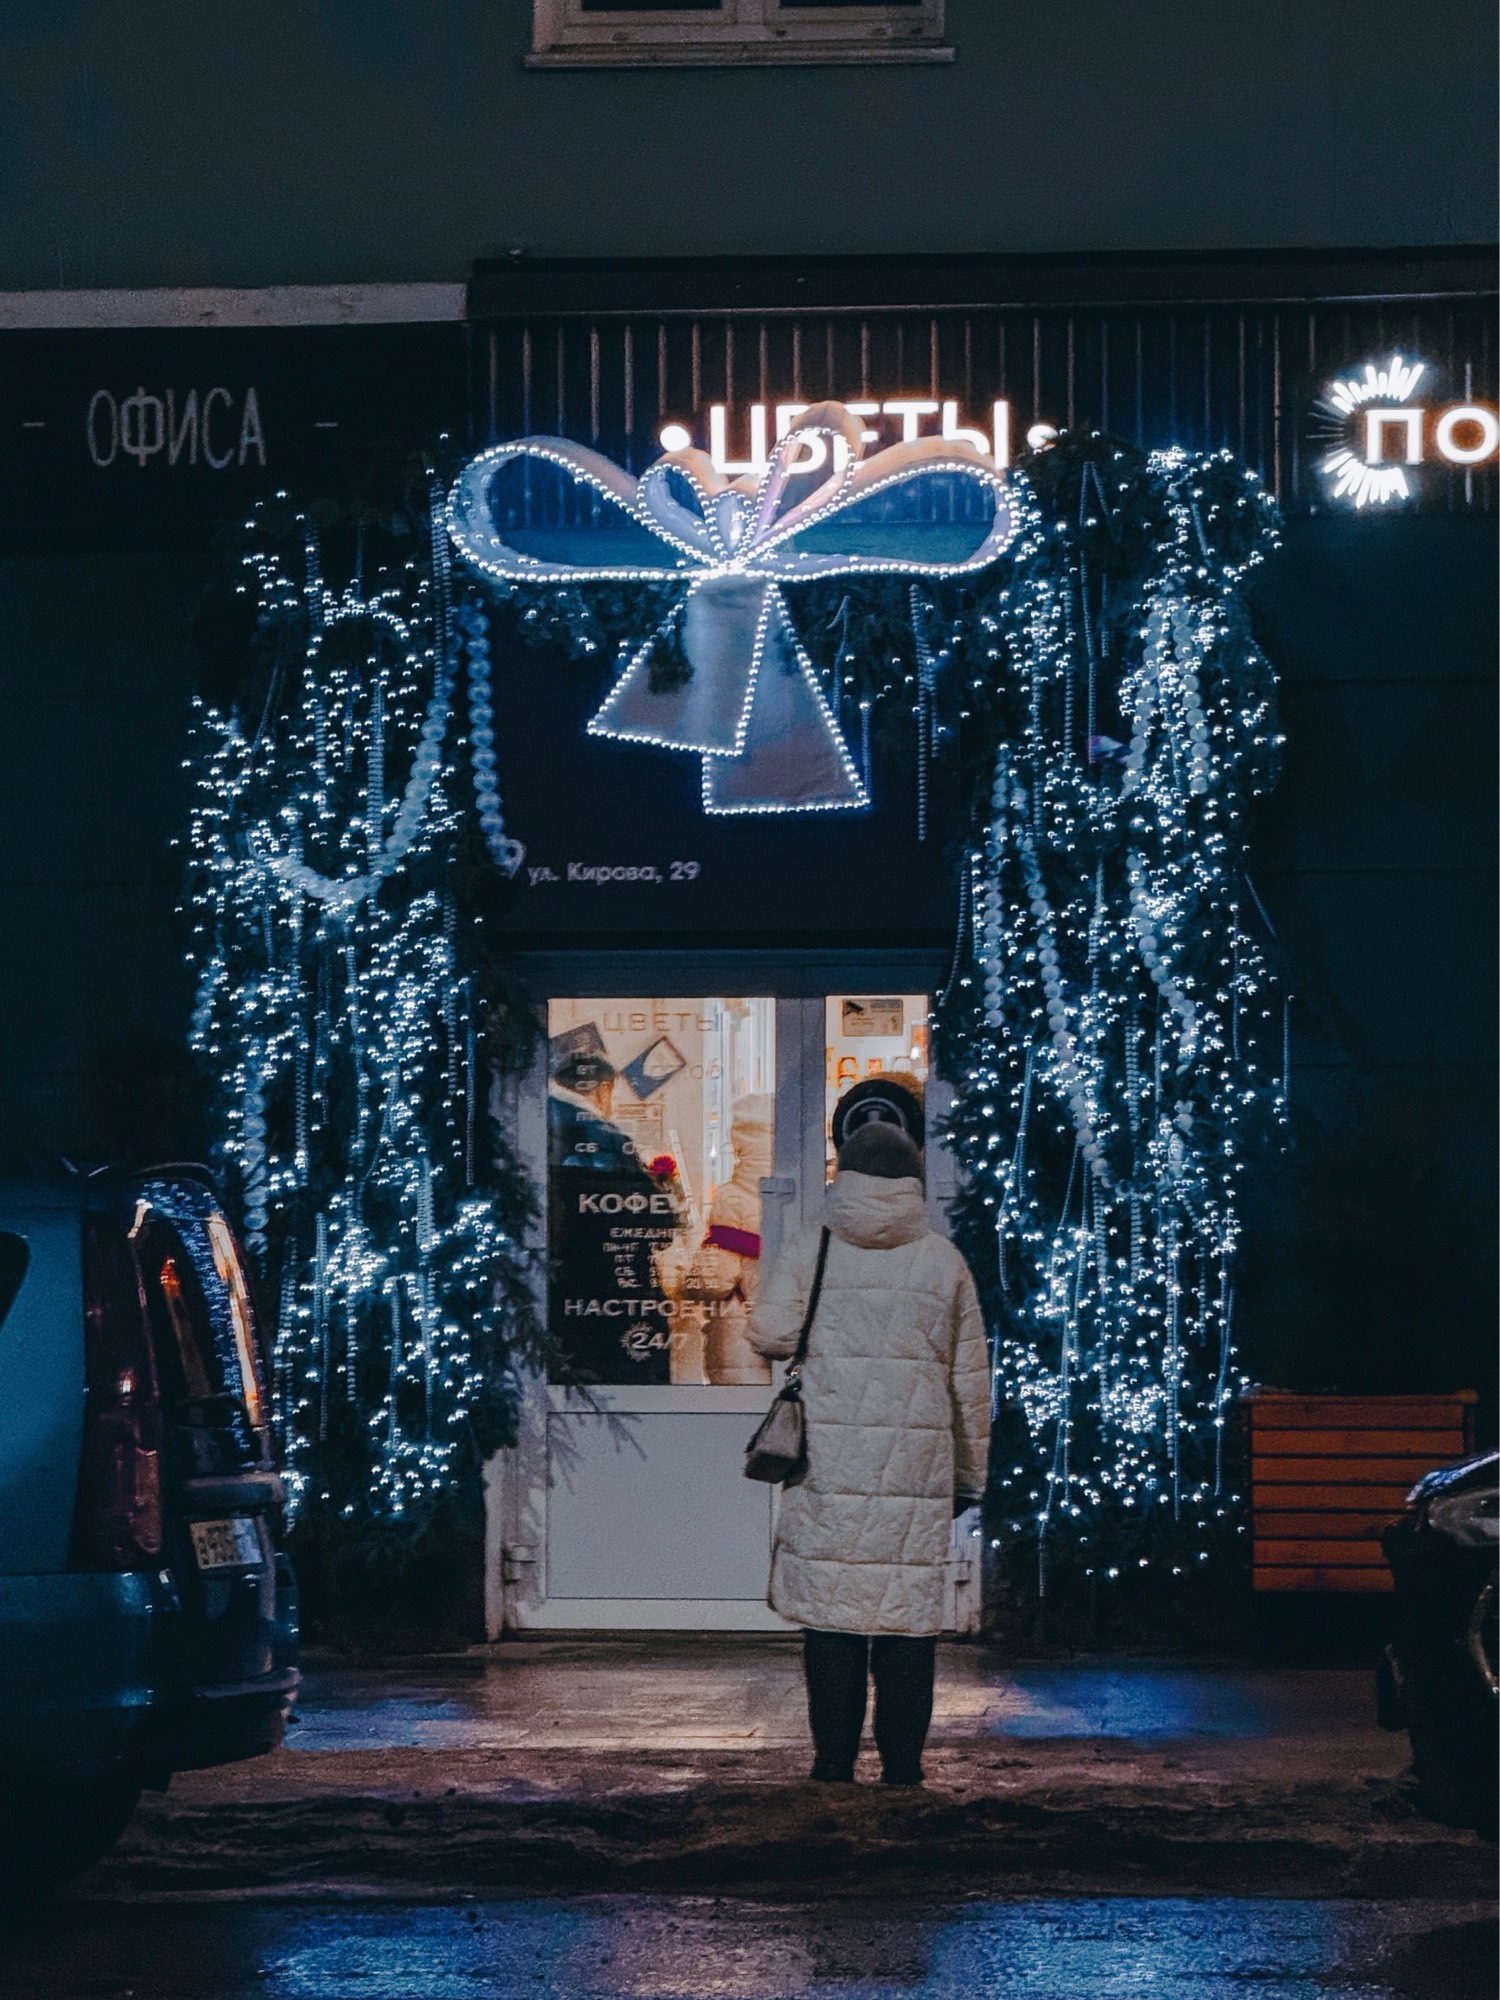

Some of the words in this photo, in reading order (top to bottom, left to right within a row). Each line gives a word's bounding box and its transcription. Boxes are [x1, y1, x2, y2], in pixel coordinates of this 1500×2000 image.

[87, 386, 266, 468] ОФИСА
[710, 401, 1009, 476] ЦВЕТЫ
[527, 866, 560, 886] ул.
[567, 862, 662, 885] Кирова,
[669, 861, 700, 880] 29
[603, 1012, 719, 1034] ЦВЕТЫ
[631, 1332, 689, 1350] 24/7
